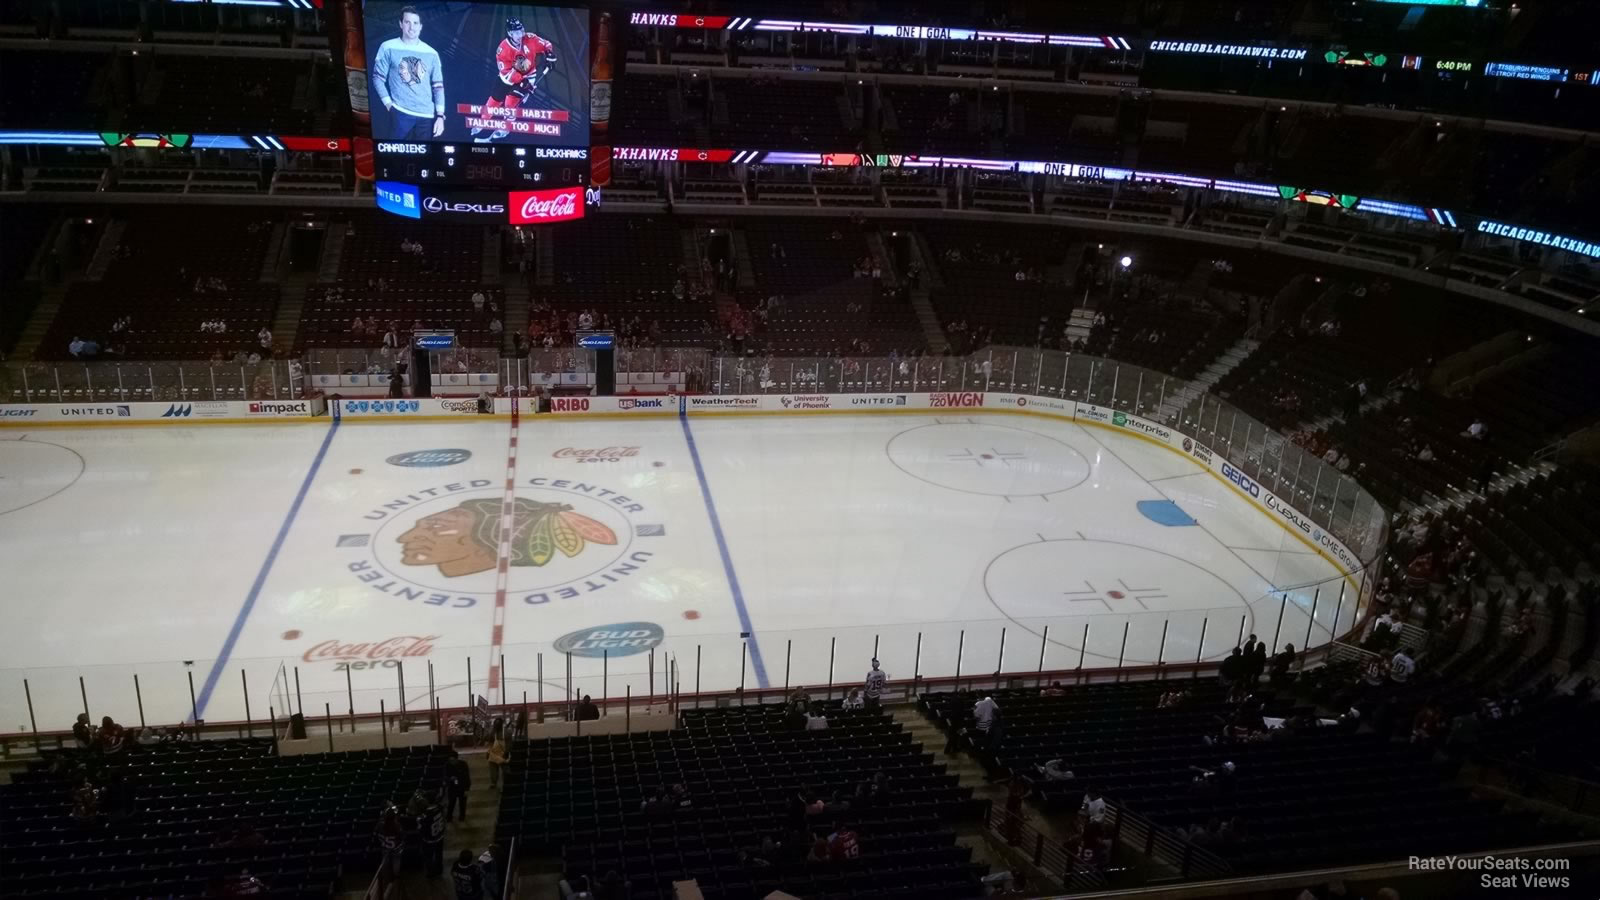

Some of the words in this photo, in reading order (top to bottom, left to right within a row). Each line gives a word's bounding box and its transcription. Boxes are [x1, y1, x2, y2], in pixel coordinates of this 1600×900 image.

[630, 13, 677, 26] HAWKS
[896, 26, 916, 38] ONE
[927, 27, 951, 39] GOAL
[1150, 41, 1306, 60] CHICAGOBLACKHAWKS.COM
[1436, 60, 1455, 70] 6:40
[1456, 62, 1472, 70] PM
[1530, 66, 1560, 75] PENGUINS
[1575, 73, 1589, 81] 1ST
[470, 104, 482, 114] MY
[487, 106, 517, 116] WORST
[522, 108, 552, 119] HABIT
[468, 118, 506, 130] TALKING
[511, 122, 530, 132] TOO
[534, 124, 558, 134] MUCH
[378, 143, 427, 154] CANADIENS
[536, 148, 588, 159] BLACKHAWKS
[1044, 164, 1066, 176] ONE
[1078, 165, 1105, 178] GOAL
[444, 202, 504, 213] LEXUS
[521, 193, 576, 218] Coca-Cola
[930, 398, 946, 407] 720
[946, 392, 984, 407] WGN
[260, 402, 306, 414] impact
[1222, 462, 1260, 498] GEICO
[364, 478, 492, 521] UNITED
[529, 476, 644, 514] CENTER
[1276, 504, 1311, 533] LEXUS
[1321, 536, 1338, 554] CME
[348, 560, 476, 608] CENTER
[524, 551, 653, 604] UNITED
[587, 630, 650, 640] BUD
[570, 638, 658, 650] LIGHT
[333, 659, 400, 672] zero
